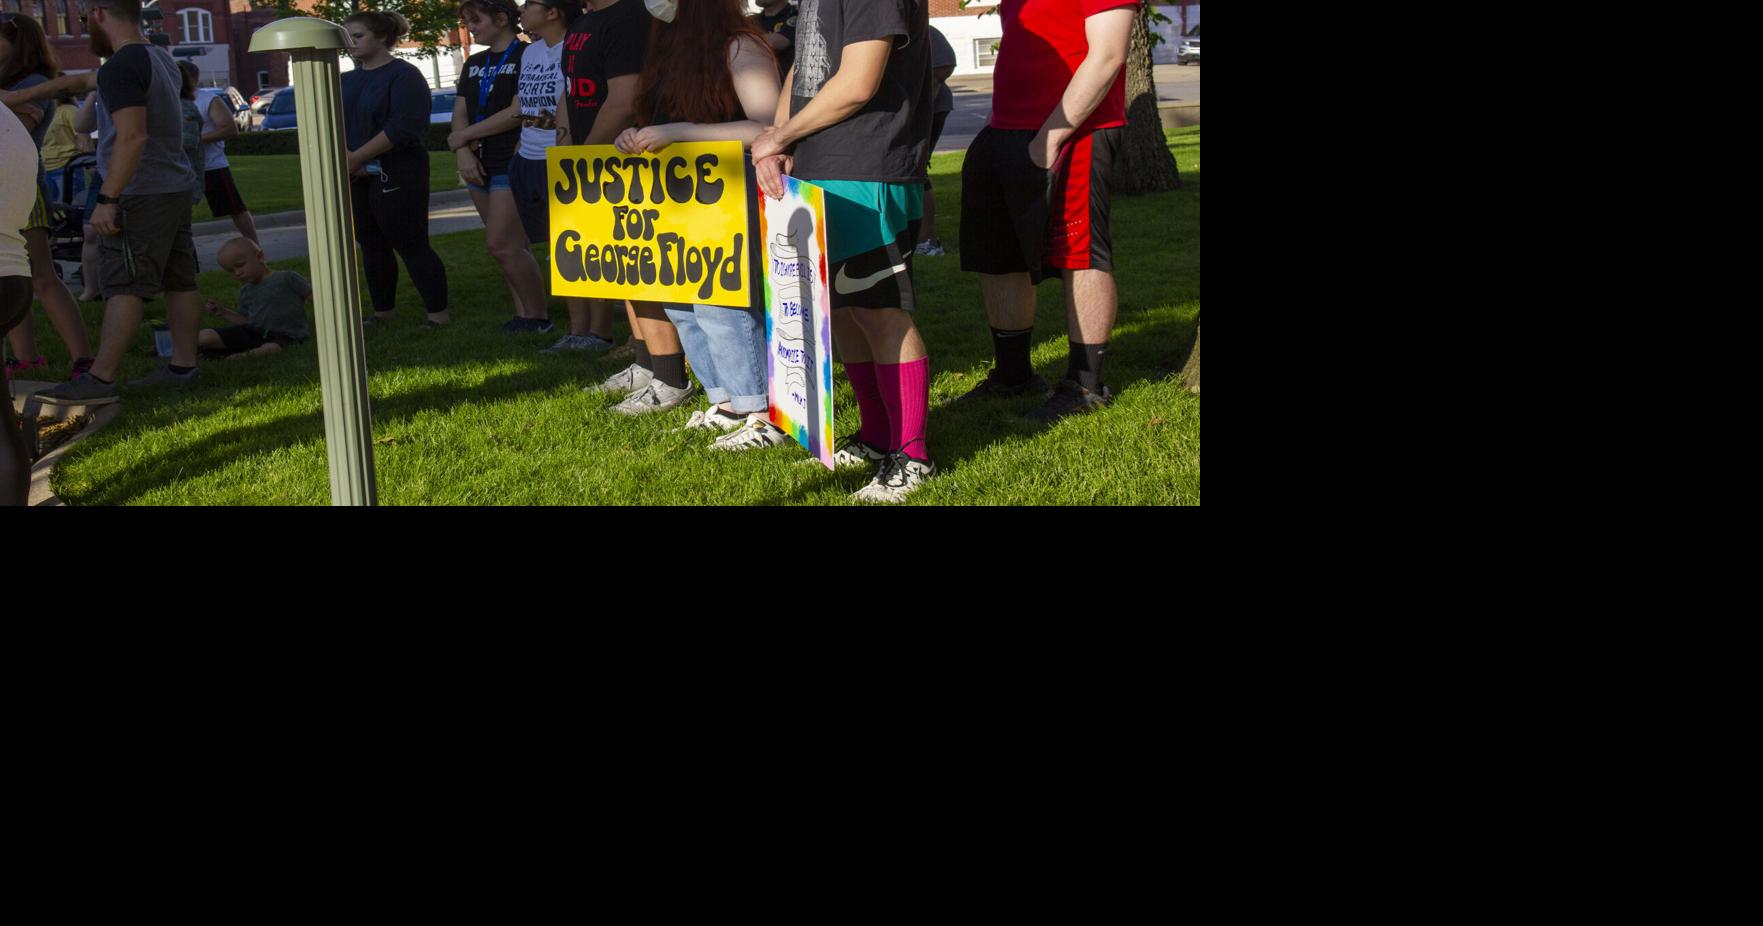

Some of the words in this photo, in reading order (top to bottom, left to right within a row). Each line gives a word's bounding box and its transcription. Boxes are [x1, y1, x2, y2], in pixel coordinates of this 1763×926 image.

[519, 81, 556, 95] PORTS
[520, 96, 556, 107] AMPION
[554, 153, 725, 205] JUSTICE
[555, 229, 657, 286] George
[657, 232, 744, 300] Floyd
